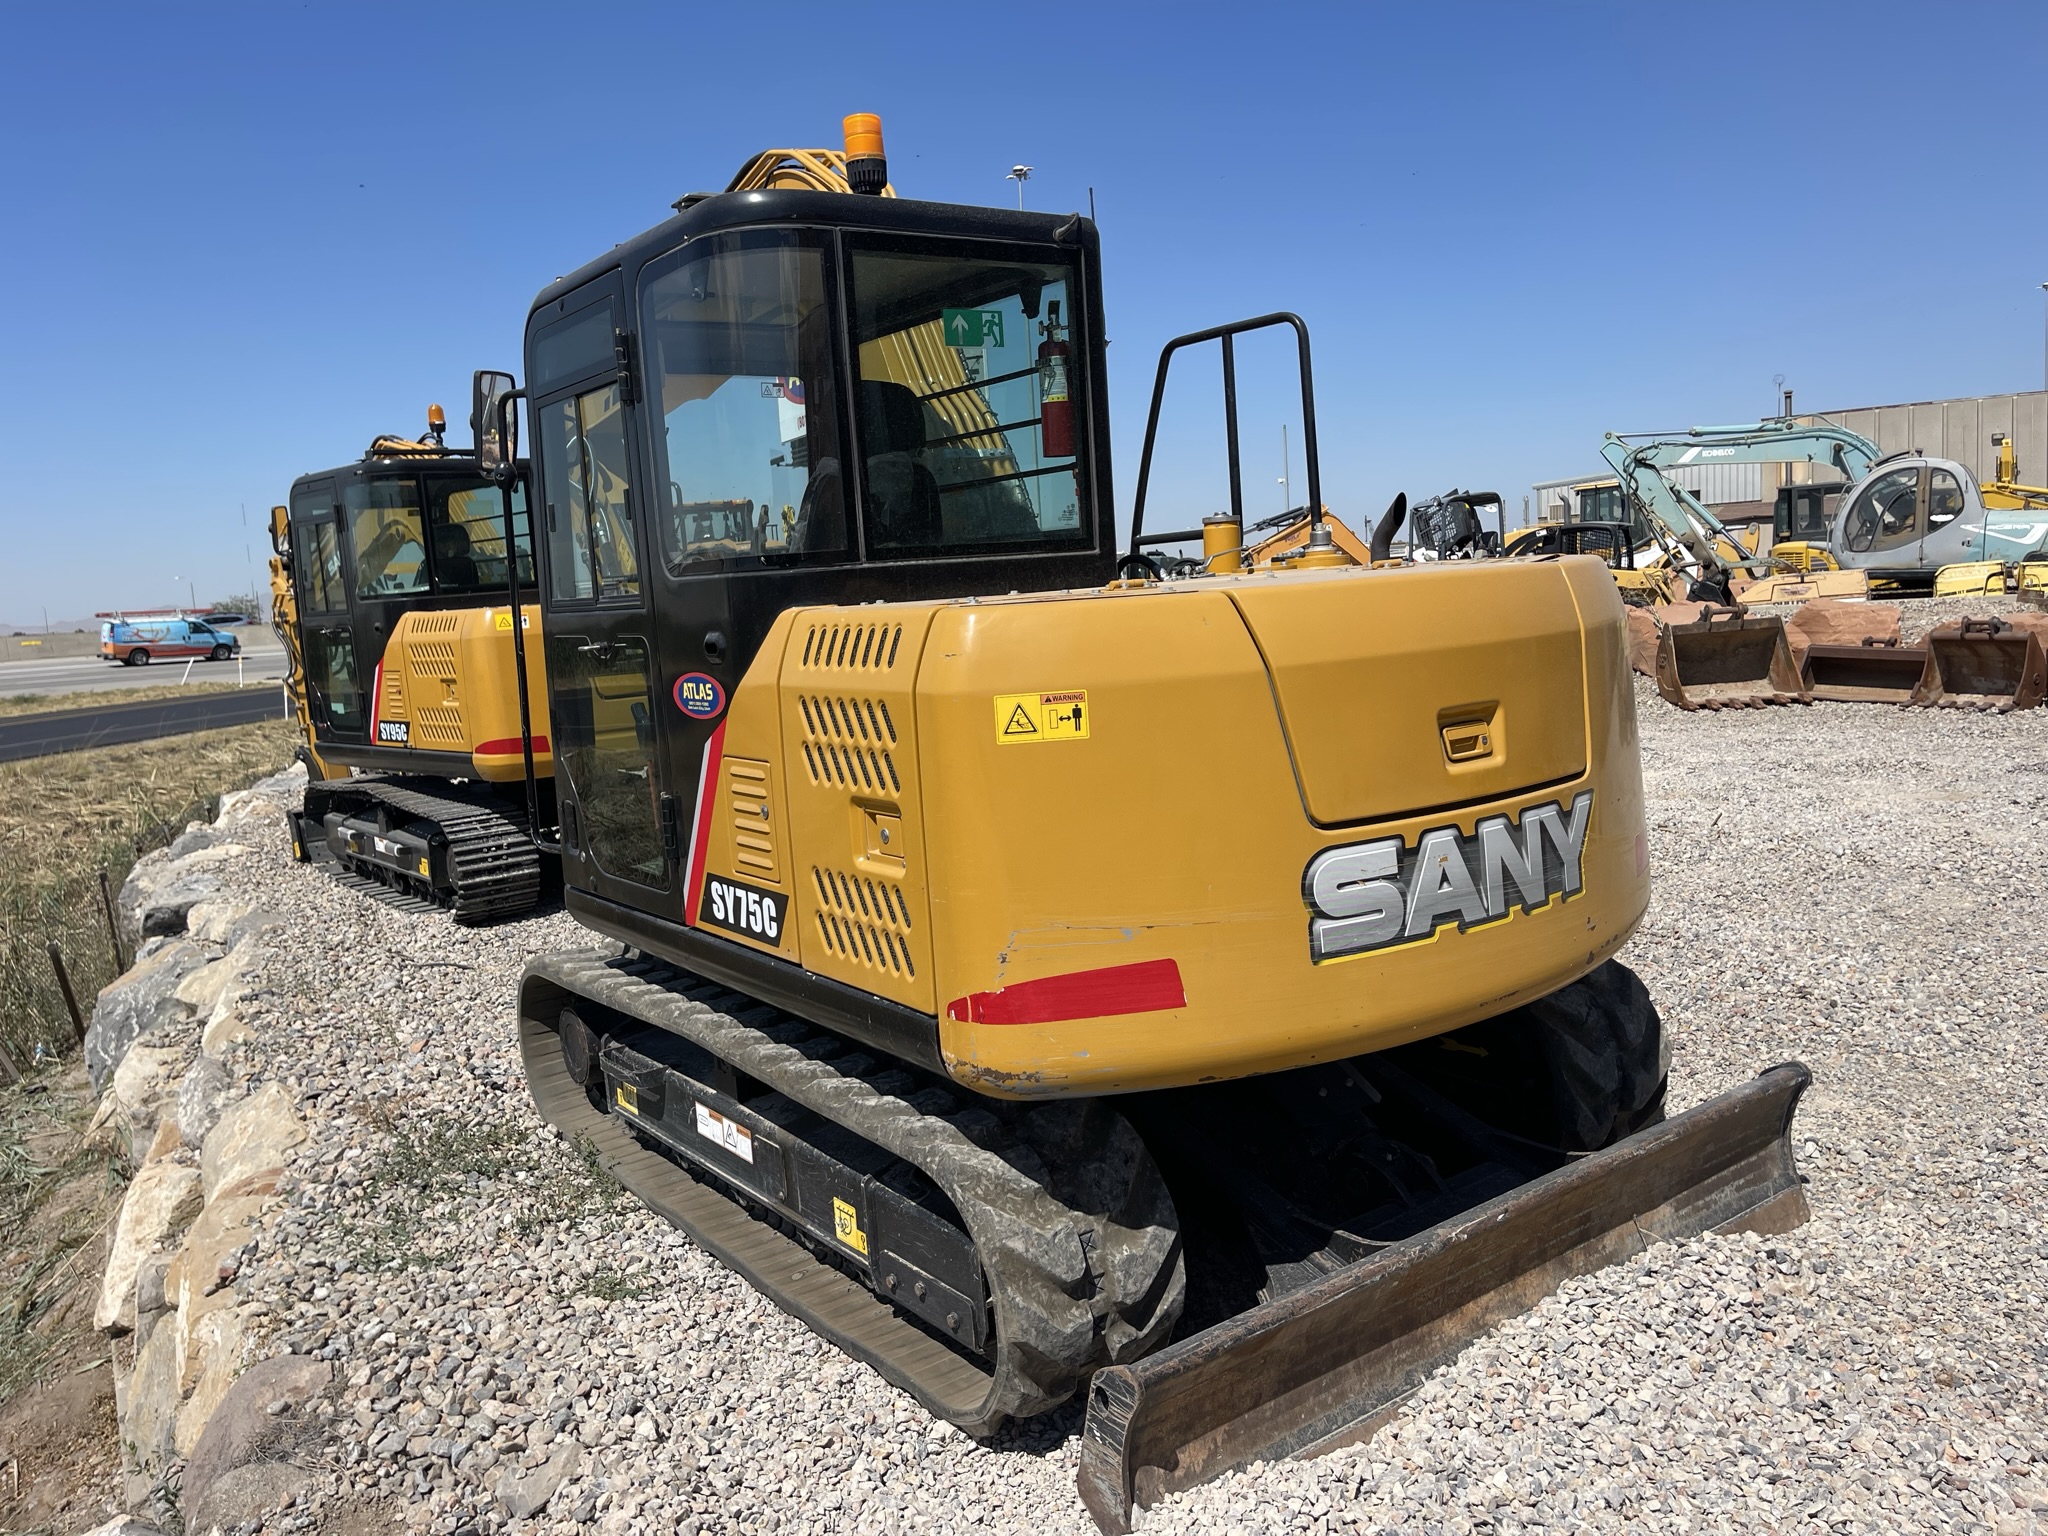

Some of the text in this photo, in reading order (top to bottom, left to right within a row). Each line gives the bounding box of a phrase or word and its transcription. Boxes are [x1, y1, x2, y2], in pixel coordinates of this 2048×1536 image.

[1702, 448, 1735, 457] KOBELCO
[683, 682, 713, 700] ATLAS
[1051, 693, 1084, 702] WARNING
[379, 722, 408, 741] SY95C
[1306, 792, 1593, 958] SANY
[710, 880, 778, 938] SY75C
